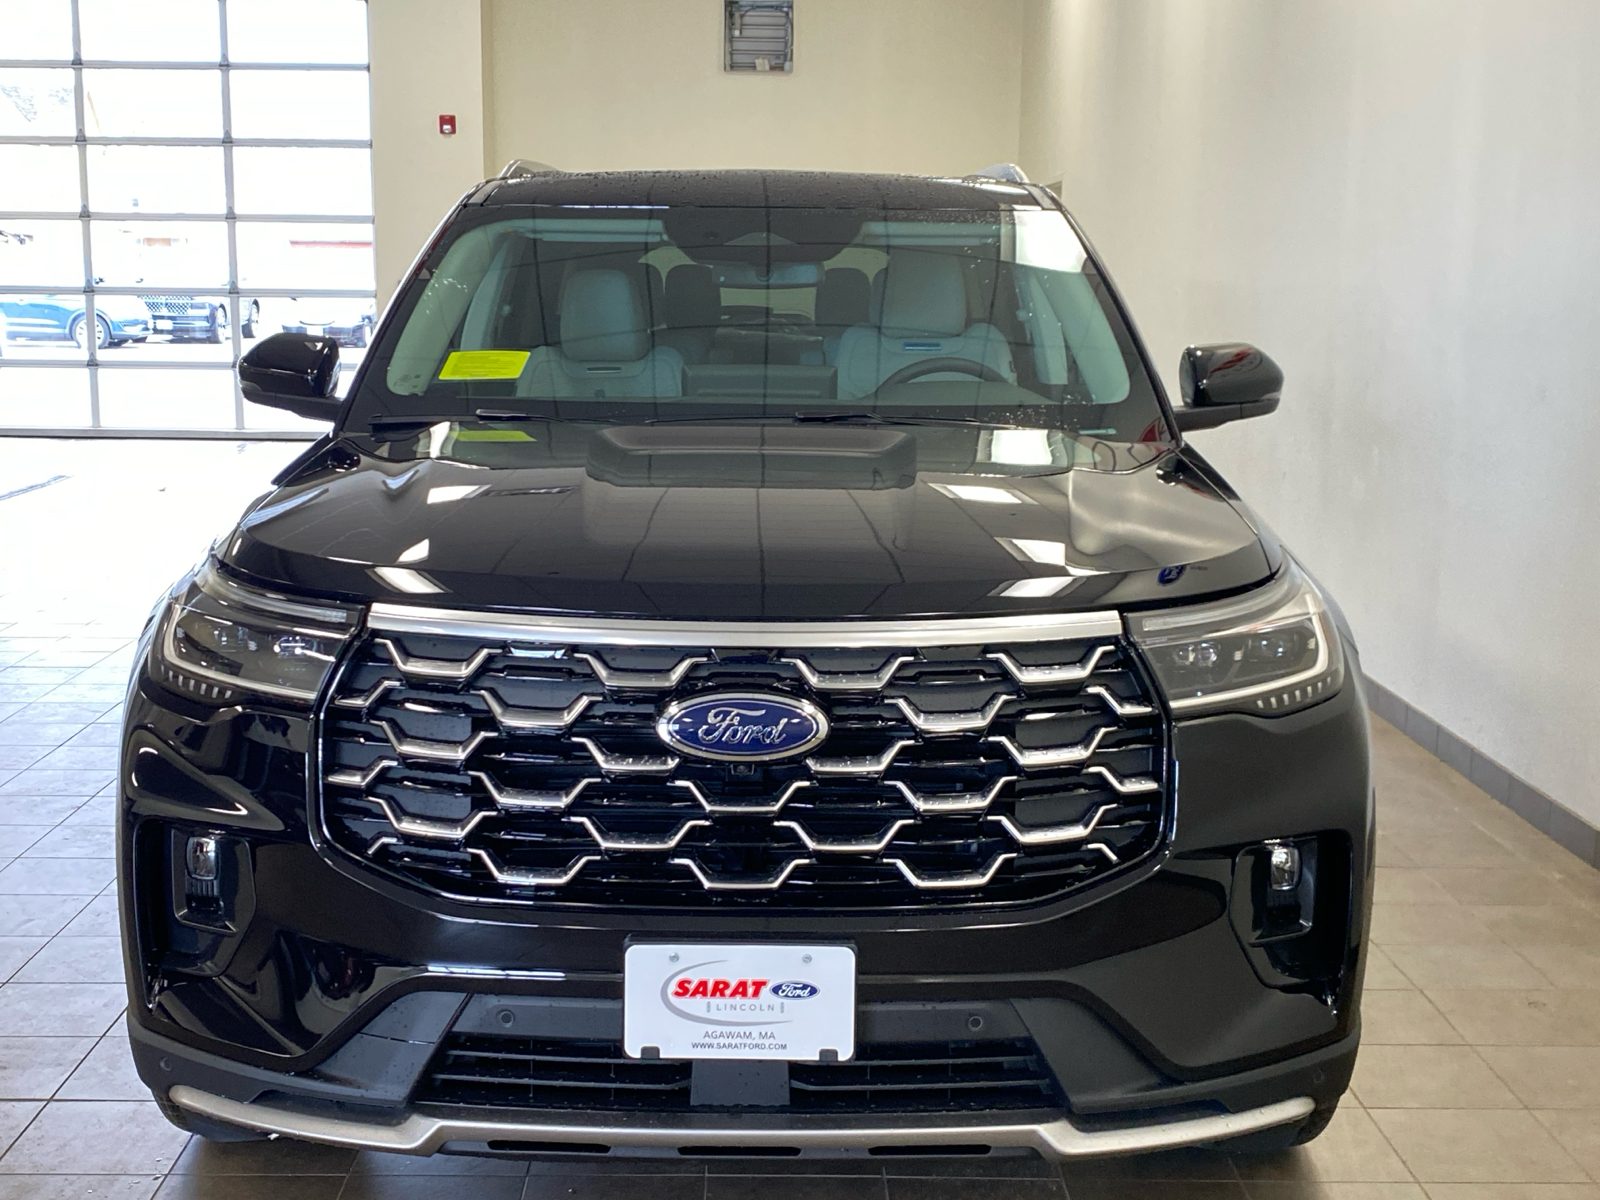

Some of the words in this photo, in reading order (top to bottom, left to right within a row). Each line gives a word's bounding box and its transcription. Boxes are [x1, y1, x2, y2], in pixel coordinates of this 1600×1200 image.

[697, 707, 789, 744] Ford
[672, 978, 769, 999] SARAT
[778, 983, 812, 997] Ford
[716, 1003, 775, 1012] LINCOLN
[703, 1031, 756, 1041] AGAWAM,
[758, 1031, 776, 1040] MA
[691, 1042, 788, 1050] WWW.SARATFORD.COM
